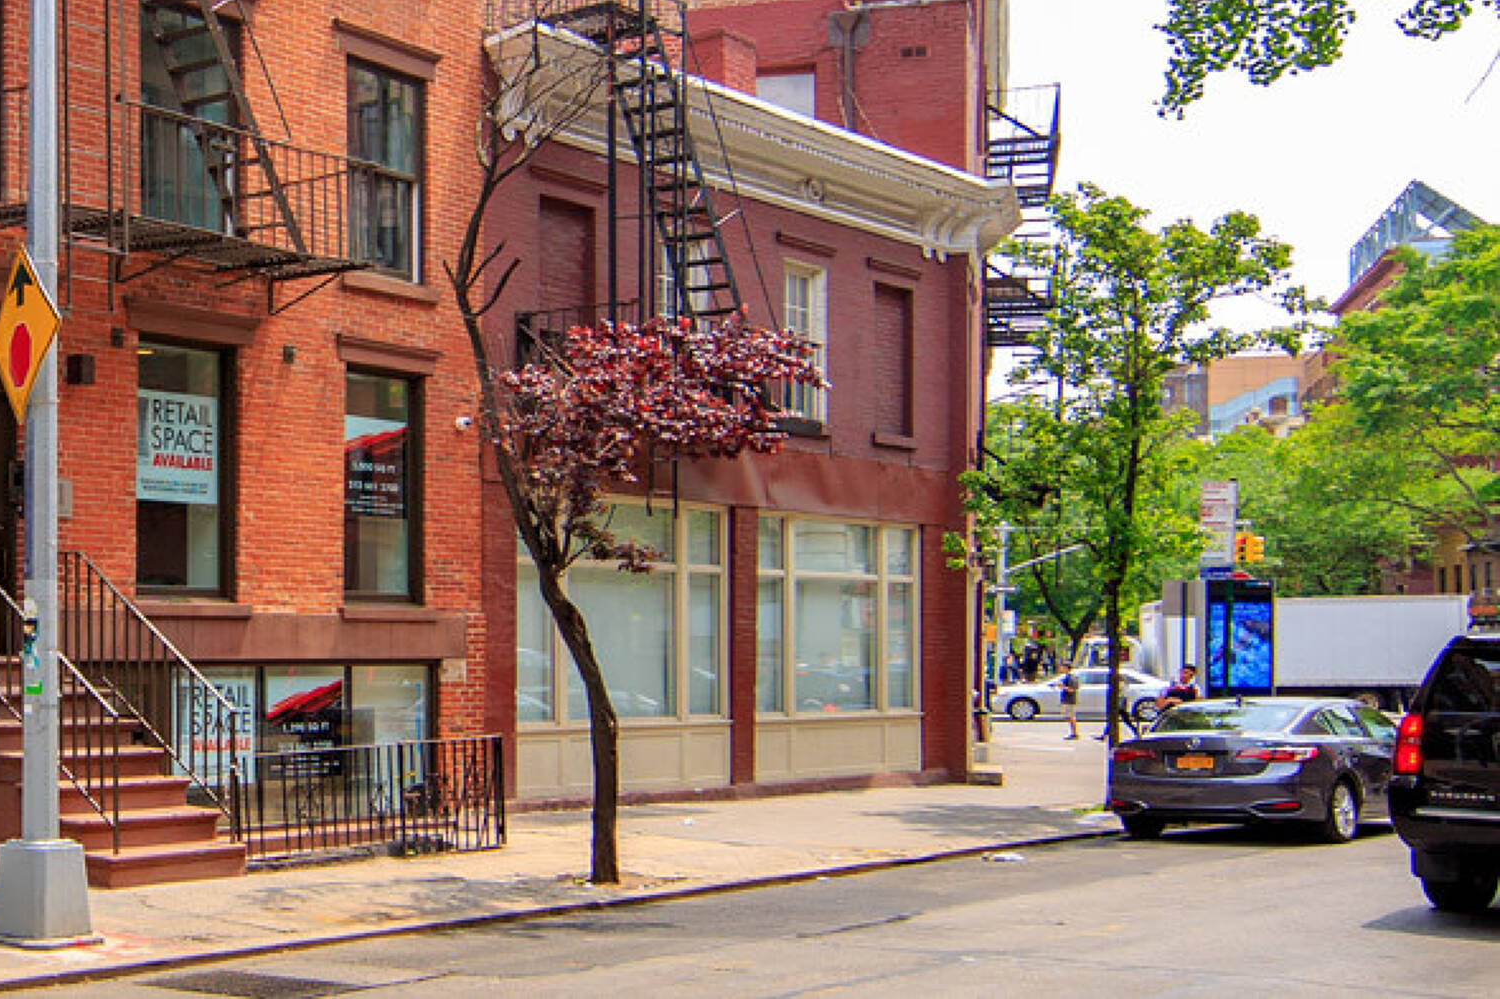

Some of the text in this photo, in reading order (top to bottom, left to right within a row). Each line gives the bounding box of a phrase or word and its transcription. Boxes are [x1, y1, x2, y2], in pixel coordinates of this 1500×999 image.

[152, 399, 212, 428] RETAIL
[151, 425, 213, 454] SPACE
[152, 452, 213, 471] AVAILABLE
